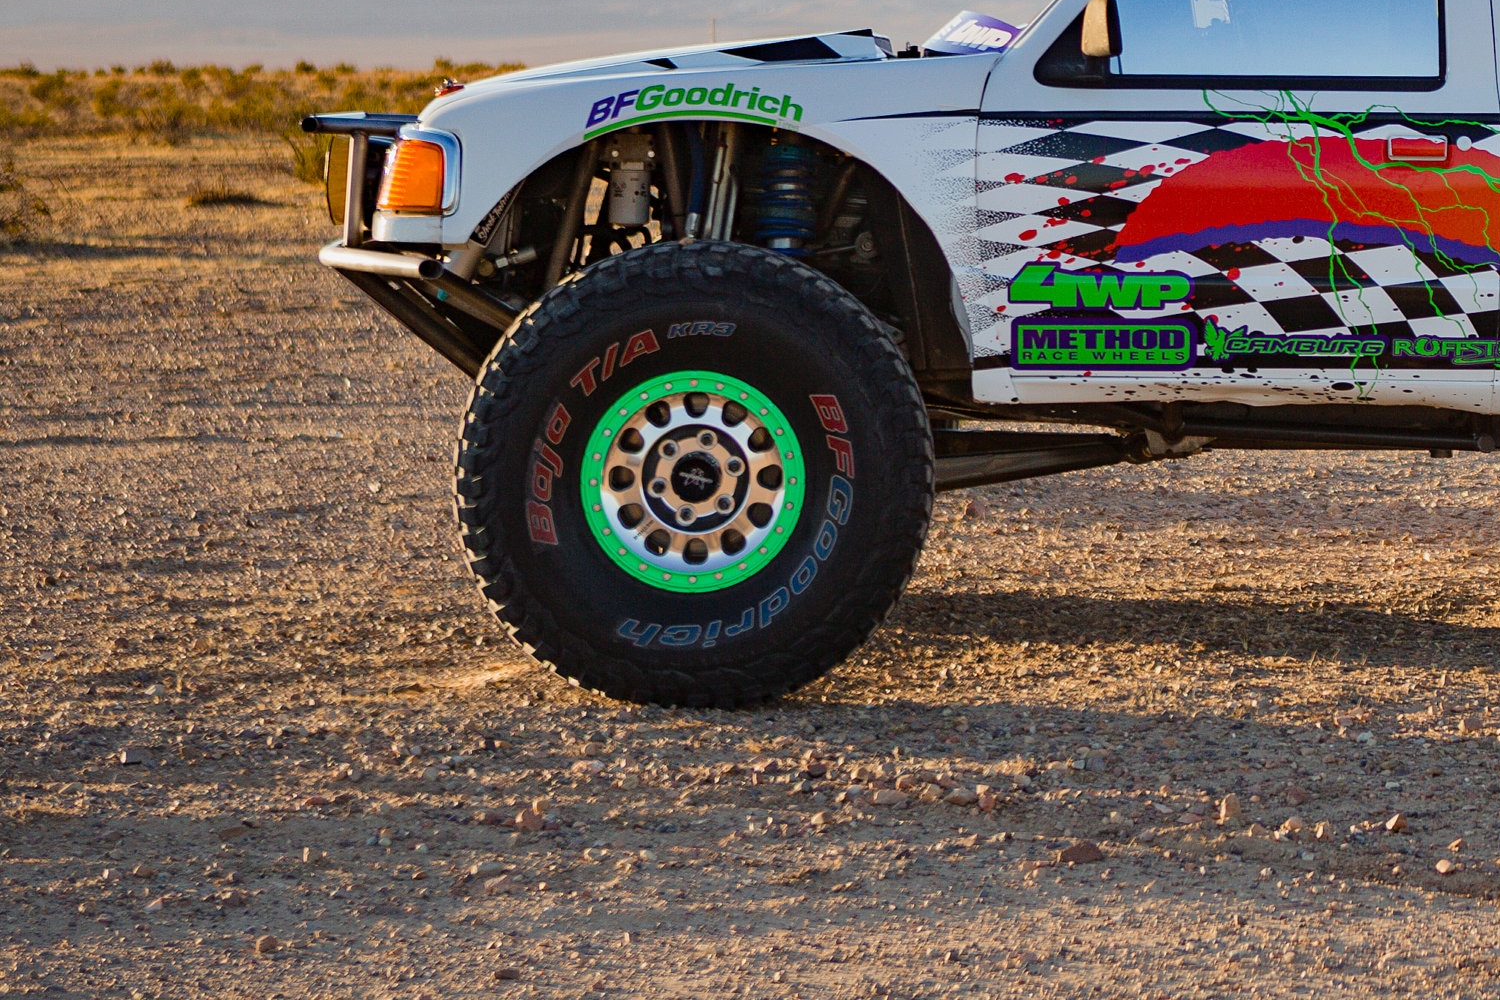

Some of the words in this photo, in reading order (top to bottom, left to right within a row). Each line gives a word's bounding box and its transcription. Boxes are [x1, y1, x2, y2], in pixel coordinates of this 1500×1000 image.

[585, 83, 804, 129] BFGoodrich
[1009, 264, 1191, 308] 4WP
[1022, 328, 1186, 350] METHOD
[1022, 351, 1079, 361] RACE
[1091, 351, 1186, 361] WHEELS
[1224, 337, 1386, 357] CAMBURG
[526, 402, 573, 546] Baja
[570, 328, 661, 397] T/A
[666, 320, 737, 340] KR3
[616, 394, 855, 648] BFGoodrich
